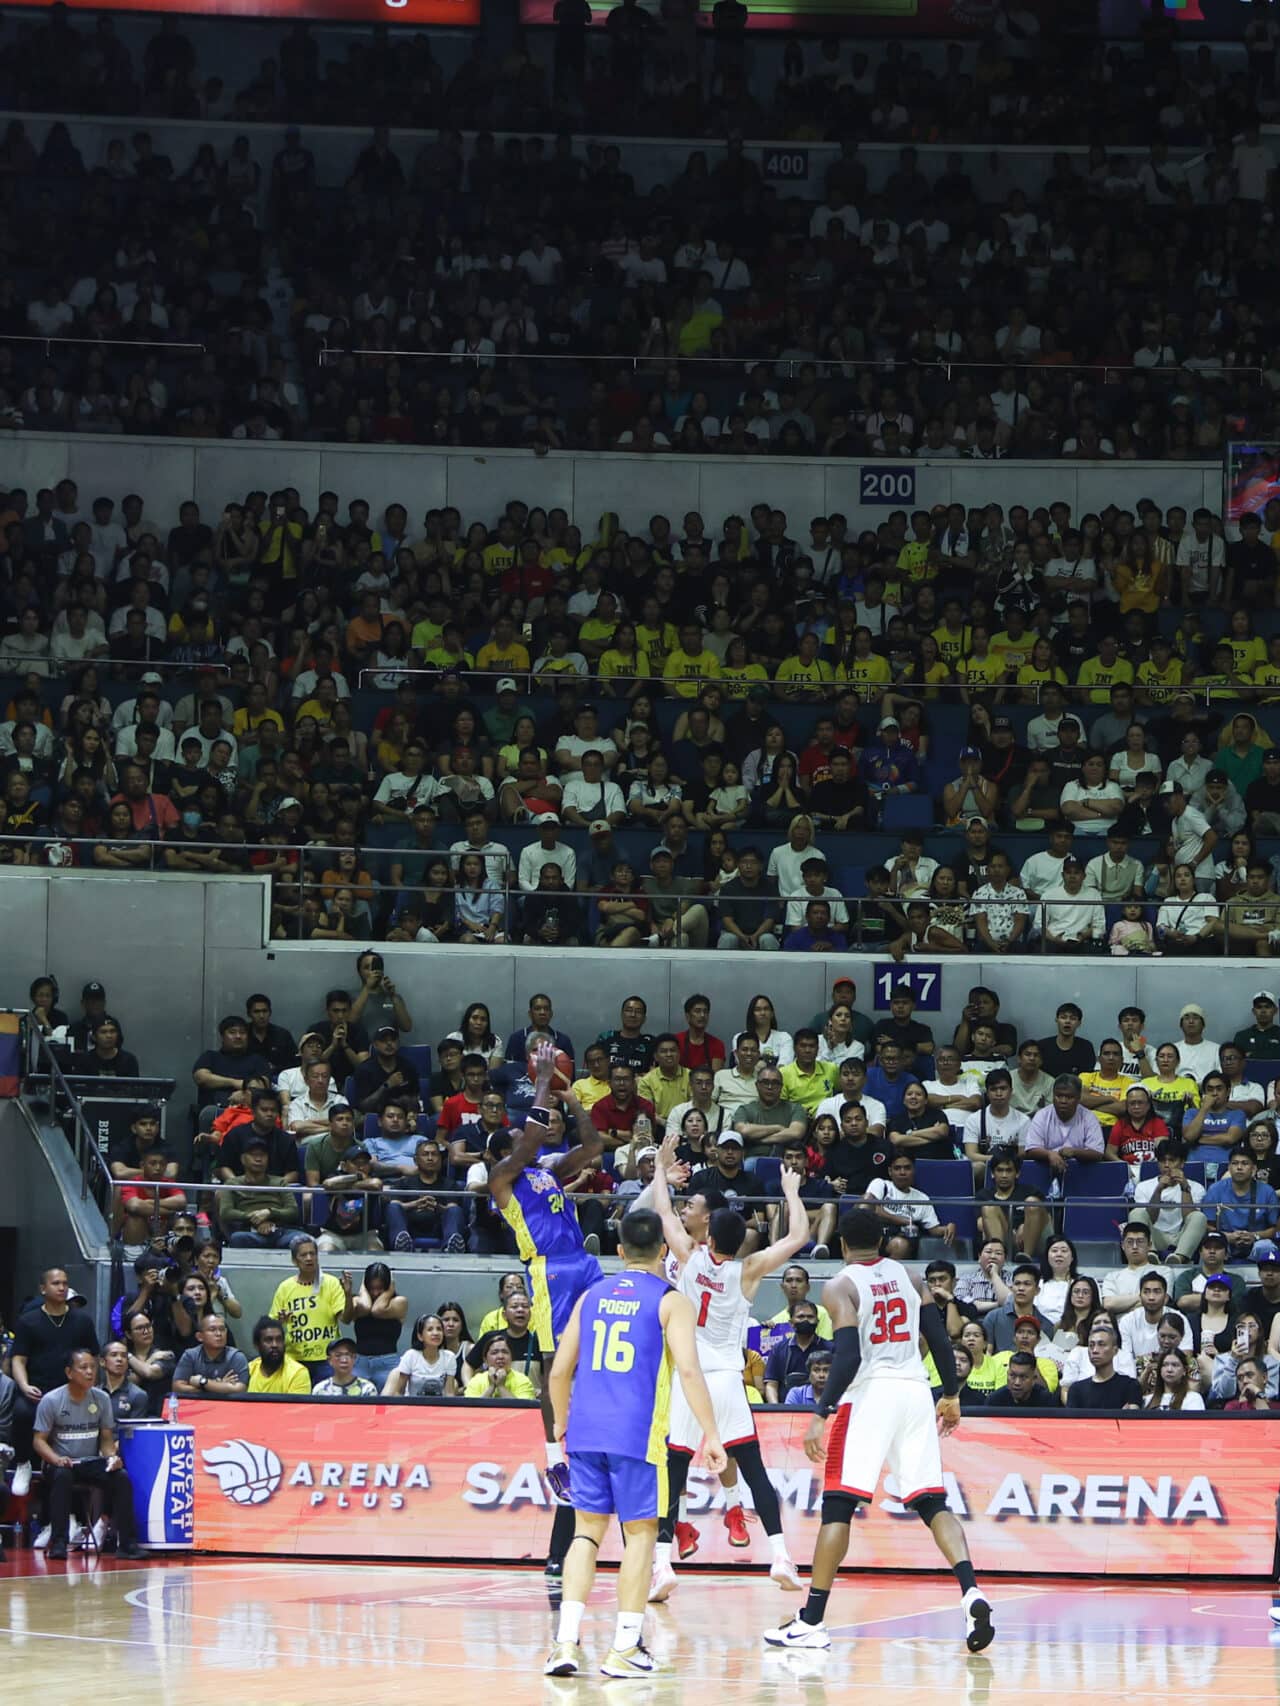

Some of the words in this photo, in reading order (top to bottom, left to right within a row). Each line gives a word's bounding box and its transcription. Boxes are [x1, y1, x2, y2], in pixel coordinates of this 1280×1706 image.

[767, 153, 805, 175] 400
[863, 473, 914, 497] 200
[1121, 1140, 1158, 1154] GINEBR
[597, 1297, 641, 1316] POGOY
[696, 1291, 713, 1329] 1
[869, 1296, 912, 1345] 32
[591, 1318, 636, 1374] 16
[170, 1434, 186, 1531] SWEAT
[288, 1462, 431, 1488] ARENA
[309, 1491, 405, 1509] PLUS
[985, 1472, 1223, 1519] ARENA
